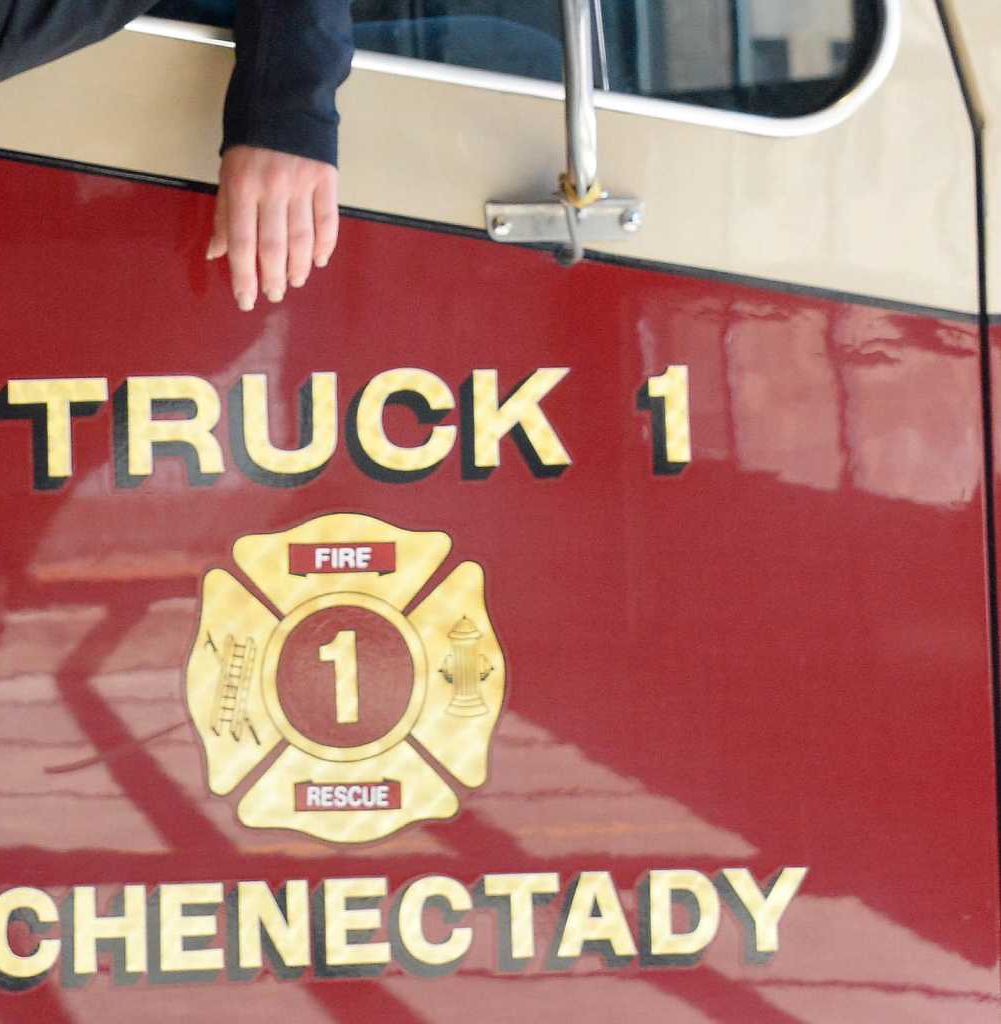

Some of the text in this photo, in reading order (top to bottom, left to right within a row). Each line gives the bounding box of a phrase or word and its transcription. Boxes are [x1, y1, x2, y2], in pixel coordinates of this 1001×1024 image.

[4, 364, 692, 481] TRUCK 1
[314, 546, 374, 570] FIRE
[318, 629, 360, 725] 1
[306, 785, 391, 808] RESCUE
